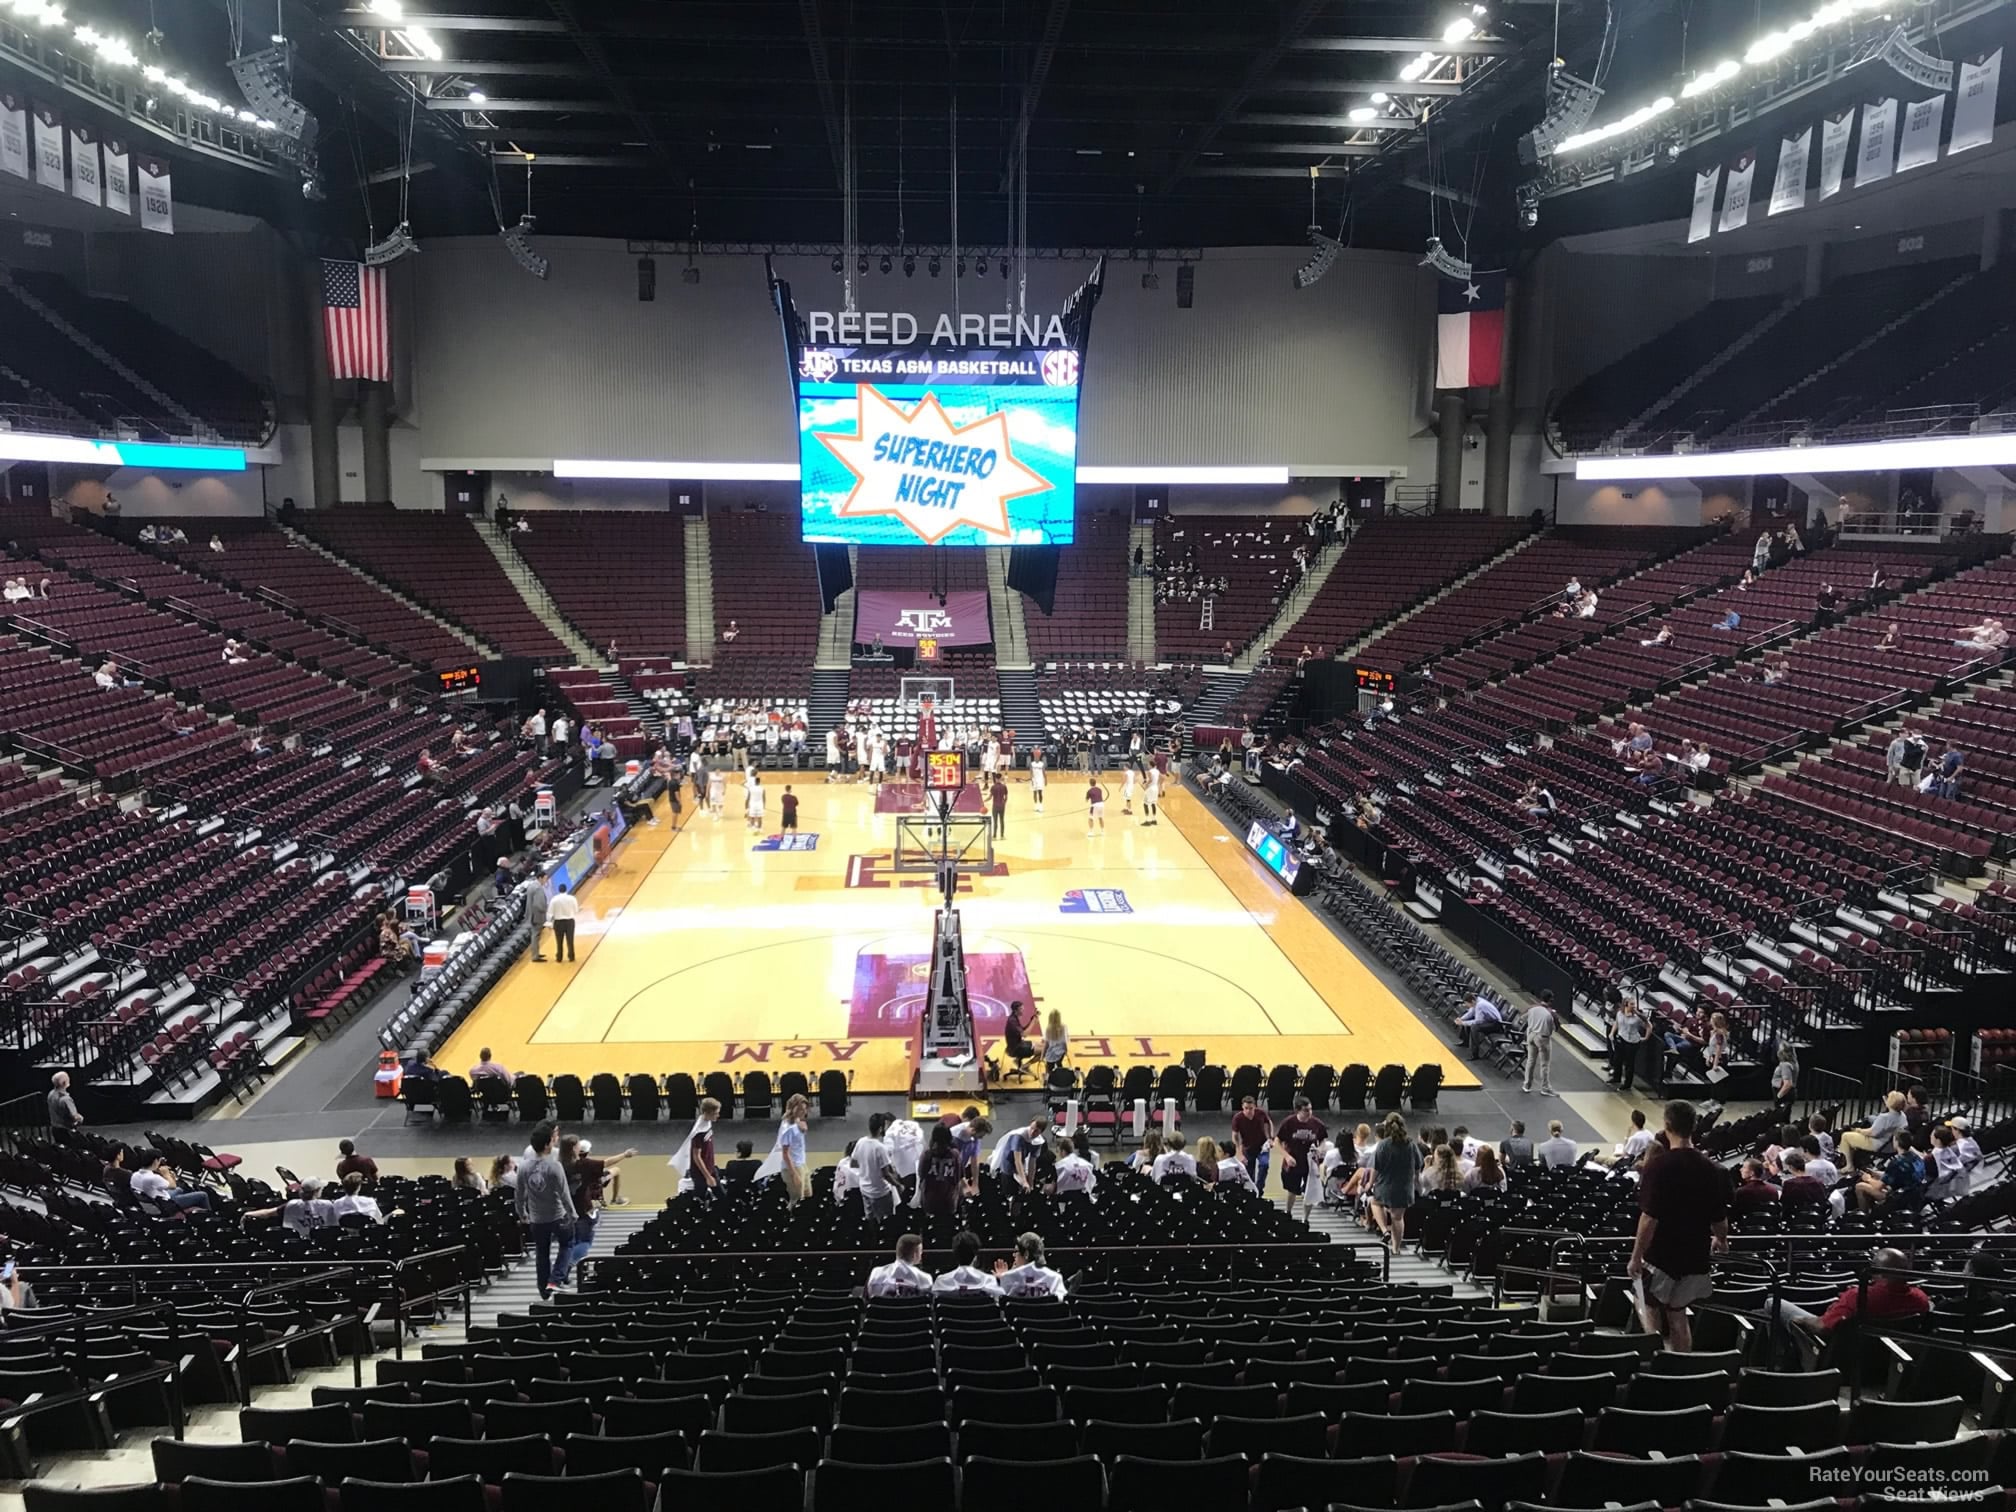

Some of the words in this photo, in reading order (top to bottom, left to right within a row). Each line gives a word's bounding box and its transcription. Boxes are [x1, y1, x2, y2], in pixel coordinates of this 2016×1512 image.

[809, 312, 918, 346] REED
[931, 313, 1068, 347] ARENA
[841, 359, 892, 374] TEXAS
[896, 360, 932, 374] A&M
[937, 360, 1036, 375] BASKETBALL
[1044, 350, 1080, 386] SEC
[873, 432, 998, 480] SUPERHERO
[894, 473, 966, 510] NIGHT
[929, 753, 961, 767] 35:04
[932, 766, 956, 786] 30
